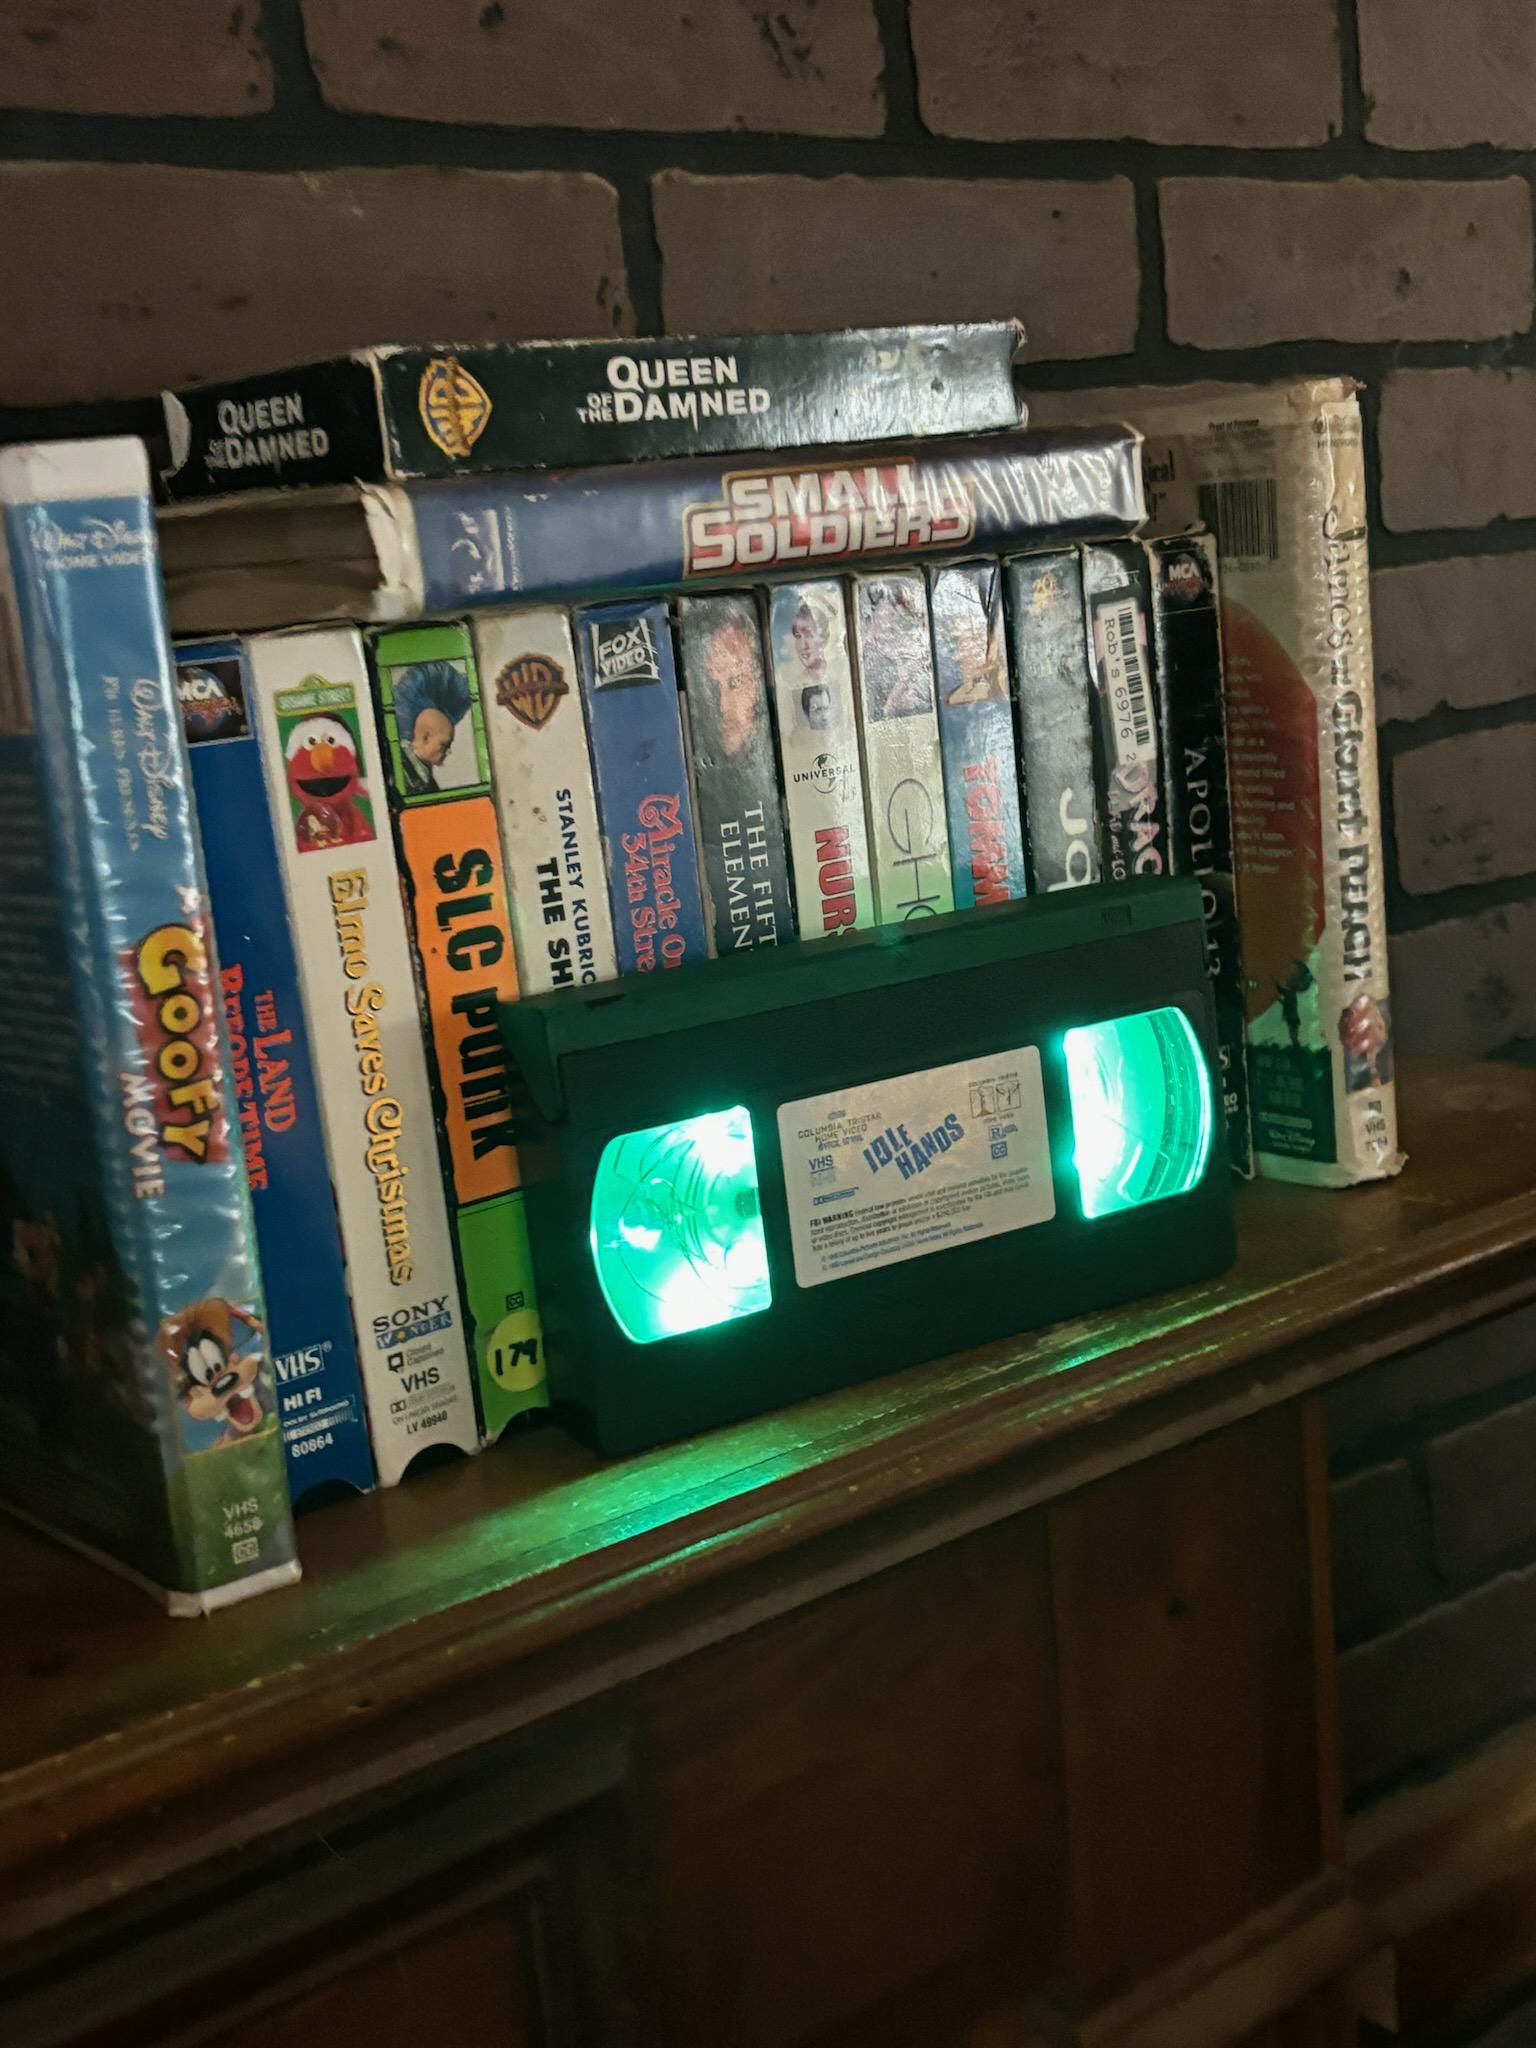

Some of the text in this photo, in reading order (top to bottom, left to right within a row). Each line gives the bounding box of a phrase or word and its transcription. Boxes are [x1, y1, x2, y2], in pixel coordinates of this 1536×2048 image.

[606, 355, 740, 394] QUEEN
[216, 392, 304, 435] QUEEN
[576, 387, 771, 432] THE DAMNED
[587, 392, 613, 410] OF
[224, 428, 329, 473] DAMNED
[731, 463, 914, 521] SMALL
[691, 478, 974, 571] SOLDIERS
[1168, 562, 1200, 582] MCA
[599, 648, 648, 678] VIDEO
[600, 629, 642, 663] FOX
[1104, 617, 1123, 680] Rob's
[1114, 686, 1136, 741] 6976
[792, 764, 857, 784] UNIVERSAL
[555, 788, 585, 890] STANLEY
[535, 856, 567, 926] THE
[719, 820, 755, 951] ELEMEN
[744, 801, 779, 947] THE FIFT
[433, 848, 506, 972] SLC
[1338, 843, 1373, 982] PEACH
[137, 922, 218, 1165] GOOFY
[253, 989, 297, 1132] THE LAND
[327, 867, 414, 1288] Elmo Saves Christmas
[119, 1072, 166, 1199] MOVIE
[863, 1123, 914, 1175] IDLE
[894, 1113, 966, 1181] HANDS
[808, 1154, 834, 1171] VHS
[372, 1295, 449, 1333] SONY
[275, 1352, 320, 1381] VHS
[400, 1367, 441, 1393] VHS
[283, 1386, 323, 1411] HI FI
[291, 1435, 334, 1459] 80864
[406, 1421, 419, 1435] LV
[222, 1497, 259, 1520] VHS
